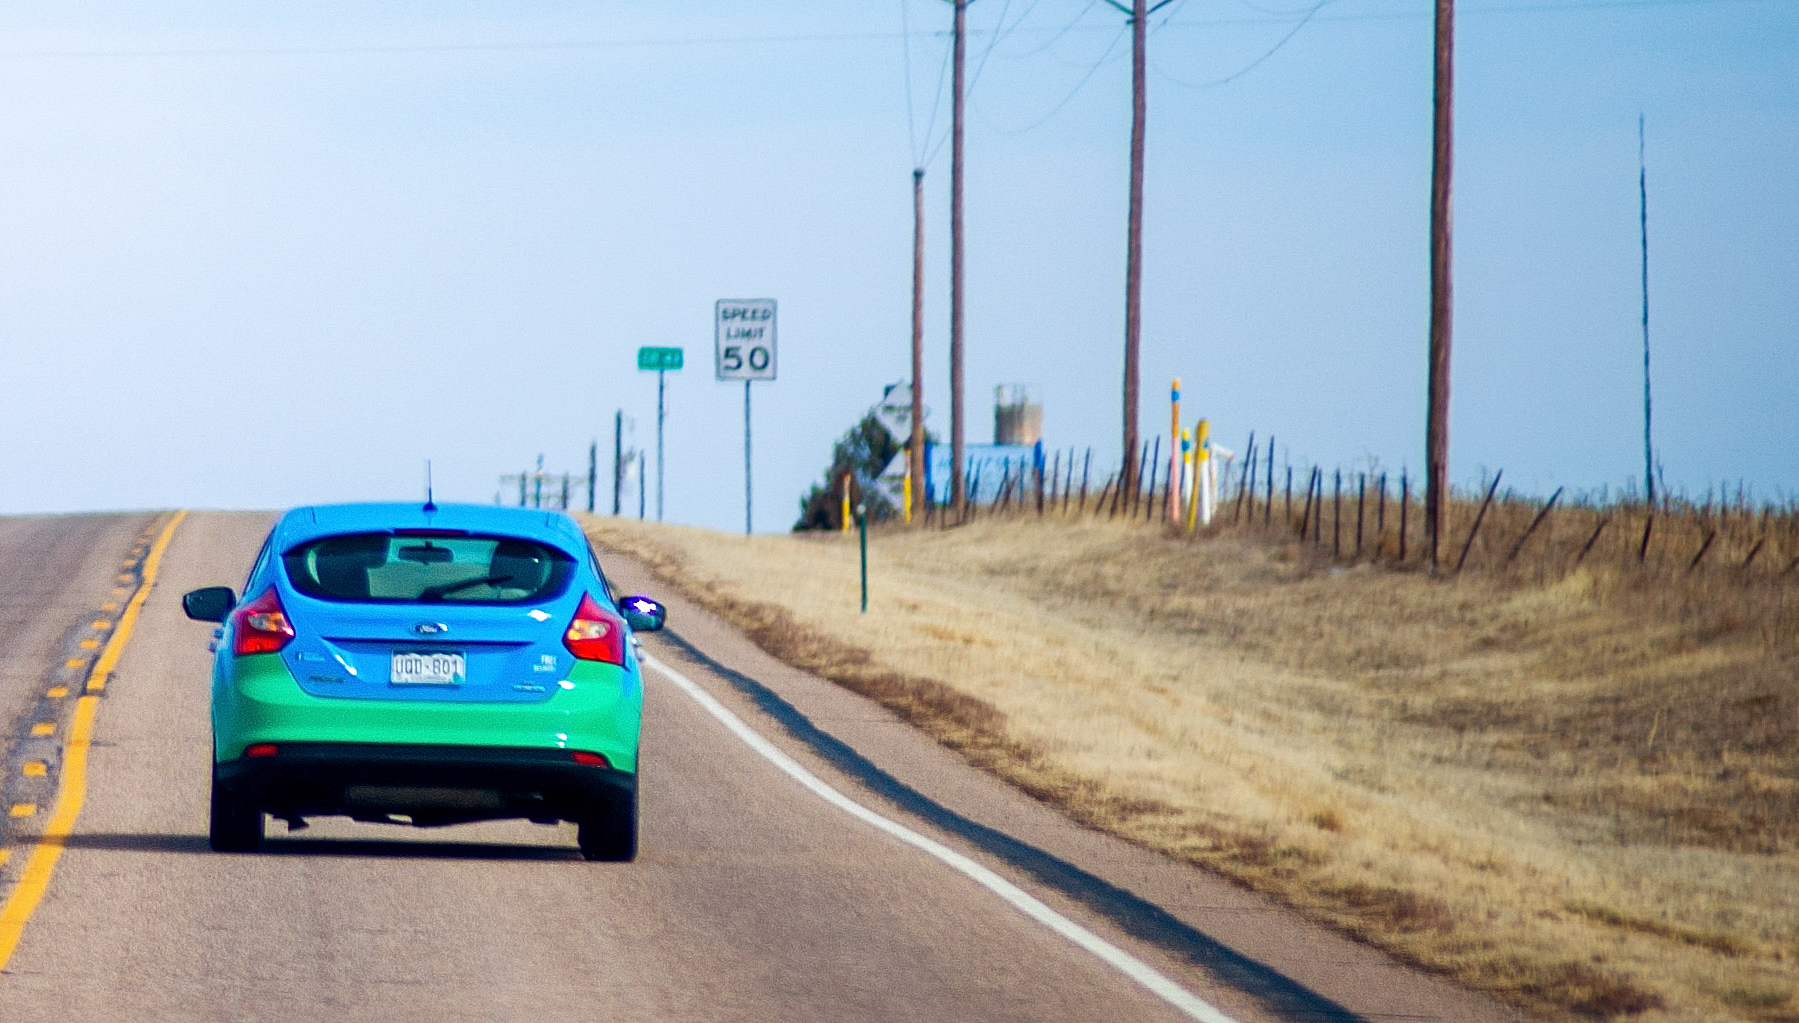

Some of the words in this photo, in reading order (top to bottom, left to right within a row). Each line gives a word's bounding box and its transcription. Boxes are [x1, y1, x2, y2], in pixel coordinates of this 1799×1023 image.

[721, 307, 771, 320] SPEED
[726, 327, 766, 340] LIMIT
[723, 345, 770, 371] 50
